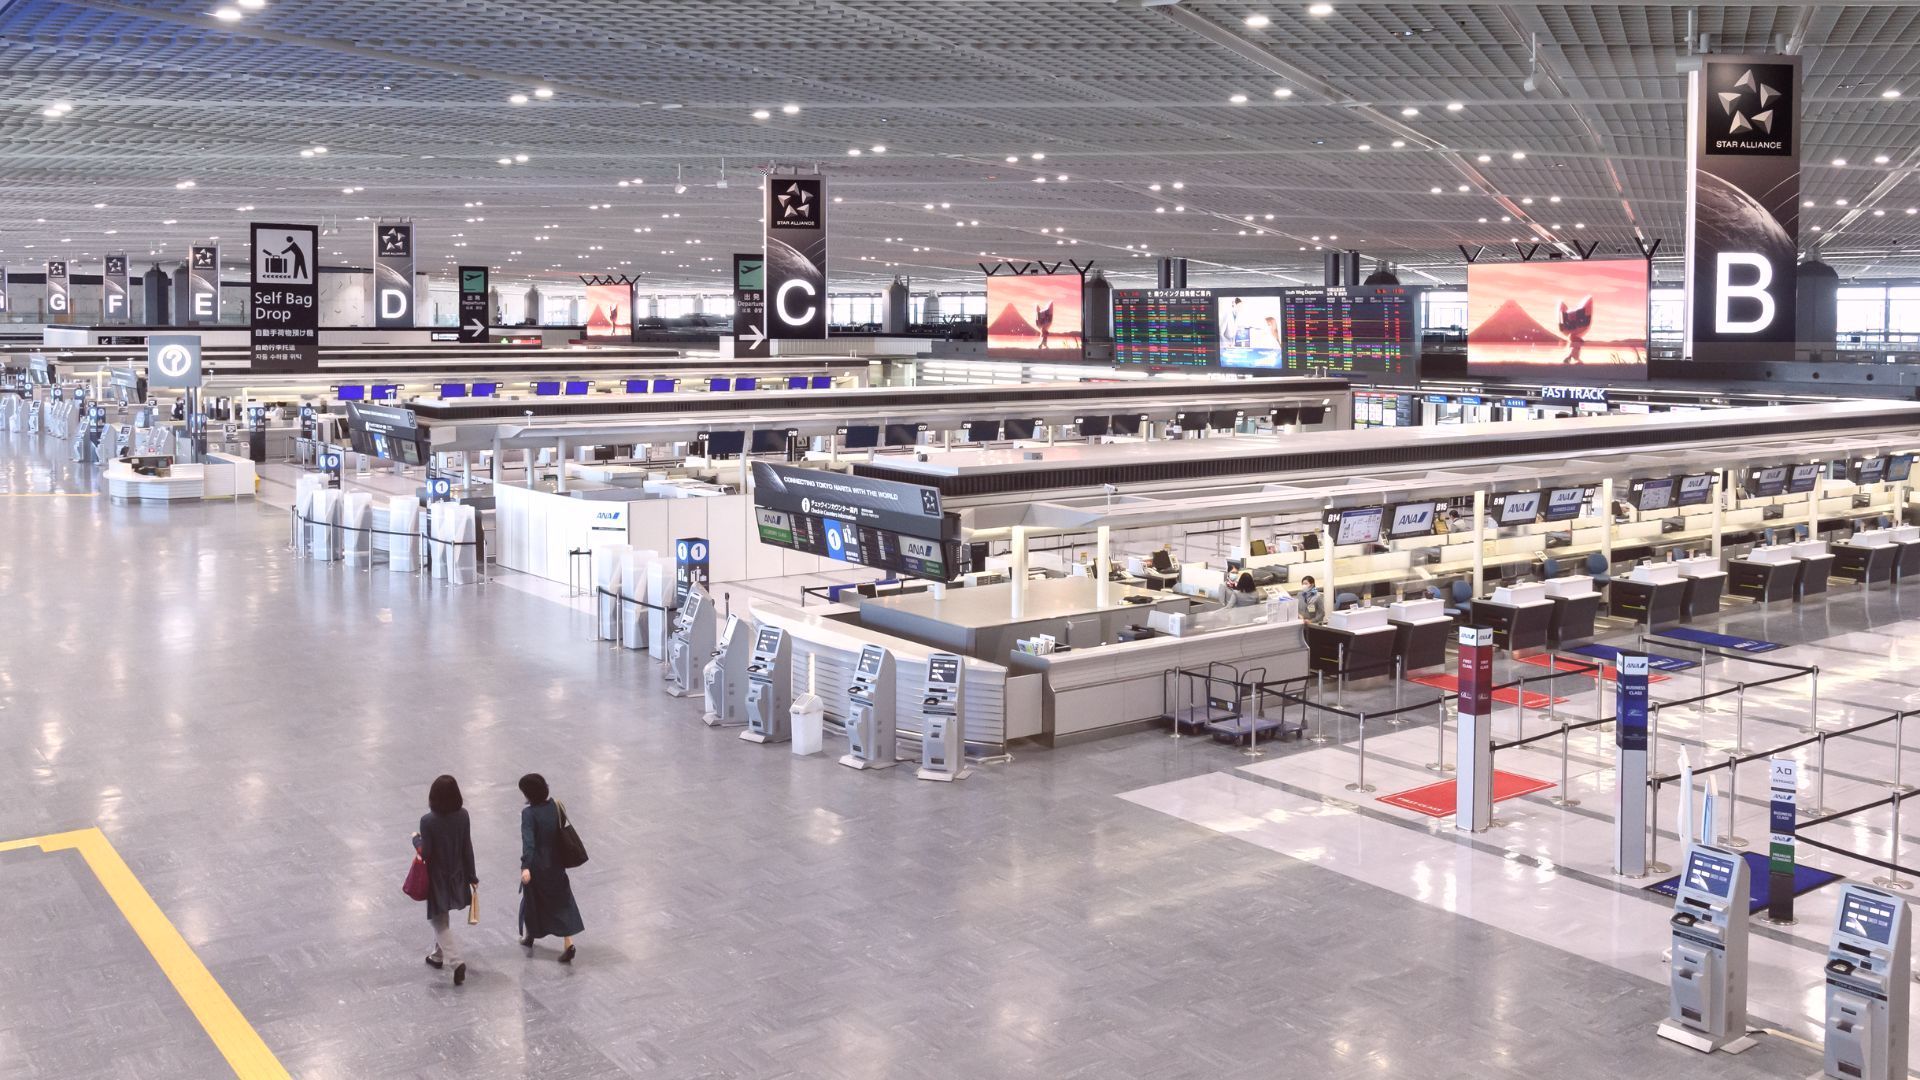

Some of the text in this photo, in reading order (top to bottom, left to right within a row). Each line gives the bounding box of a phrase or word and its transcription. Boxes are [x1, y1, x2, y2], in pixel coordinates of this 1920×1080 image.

[1716, 140, 1782, 149] STAR ALLIANCE
[1715, 252, 1775, 334] B
[50, 293, 66, 311] G
[108, 295, 123, 313] F
[195, 293, 213, 315] E
[255, 292, 312, 308] Self Bag
[381, 289, 407, 319] D
[776, 279, 816, 326] C
[255, 308, 291, 322] Drop
[1541, 387, 1606, 400] FAST TRACK
[784, 476, 898, 500] CONNECTING TOKYO NARITA WITH THE WORLD
[1436, 502, 1448, 511] B15
[1508, 503, 1525, 513] ANA
[764, 514, 777, 524] ANA
[1328, 514, 1340, 522] B14
[1398, 514, 1418, 525] ANA
[908, 543, 924, 556] ANA
[1776, 766, 1792, 775] 入口
